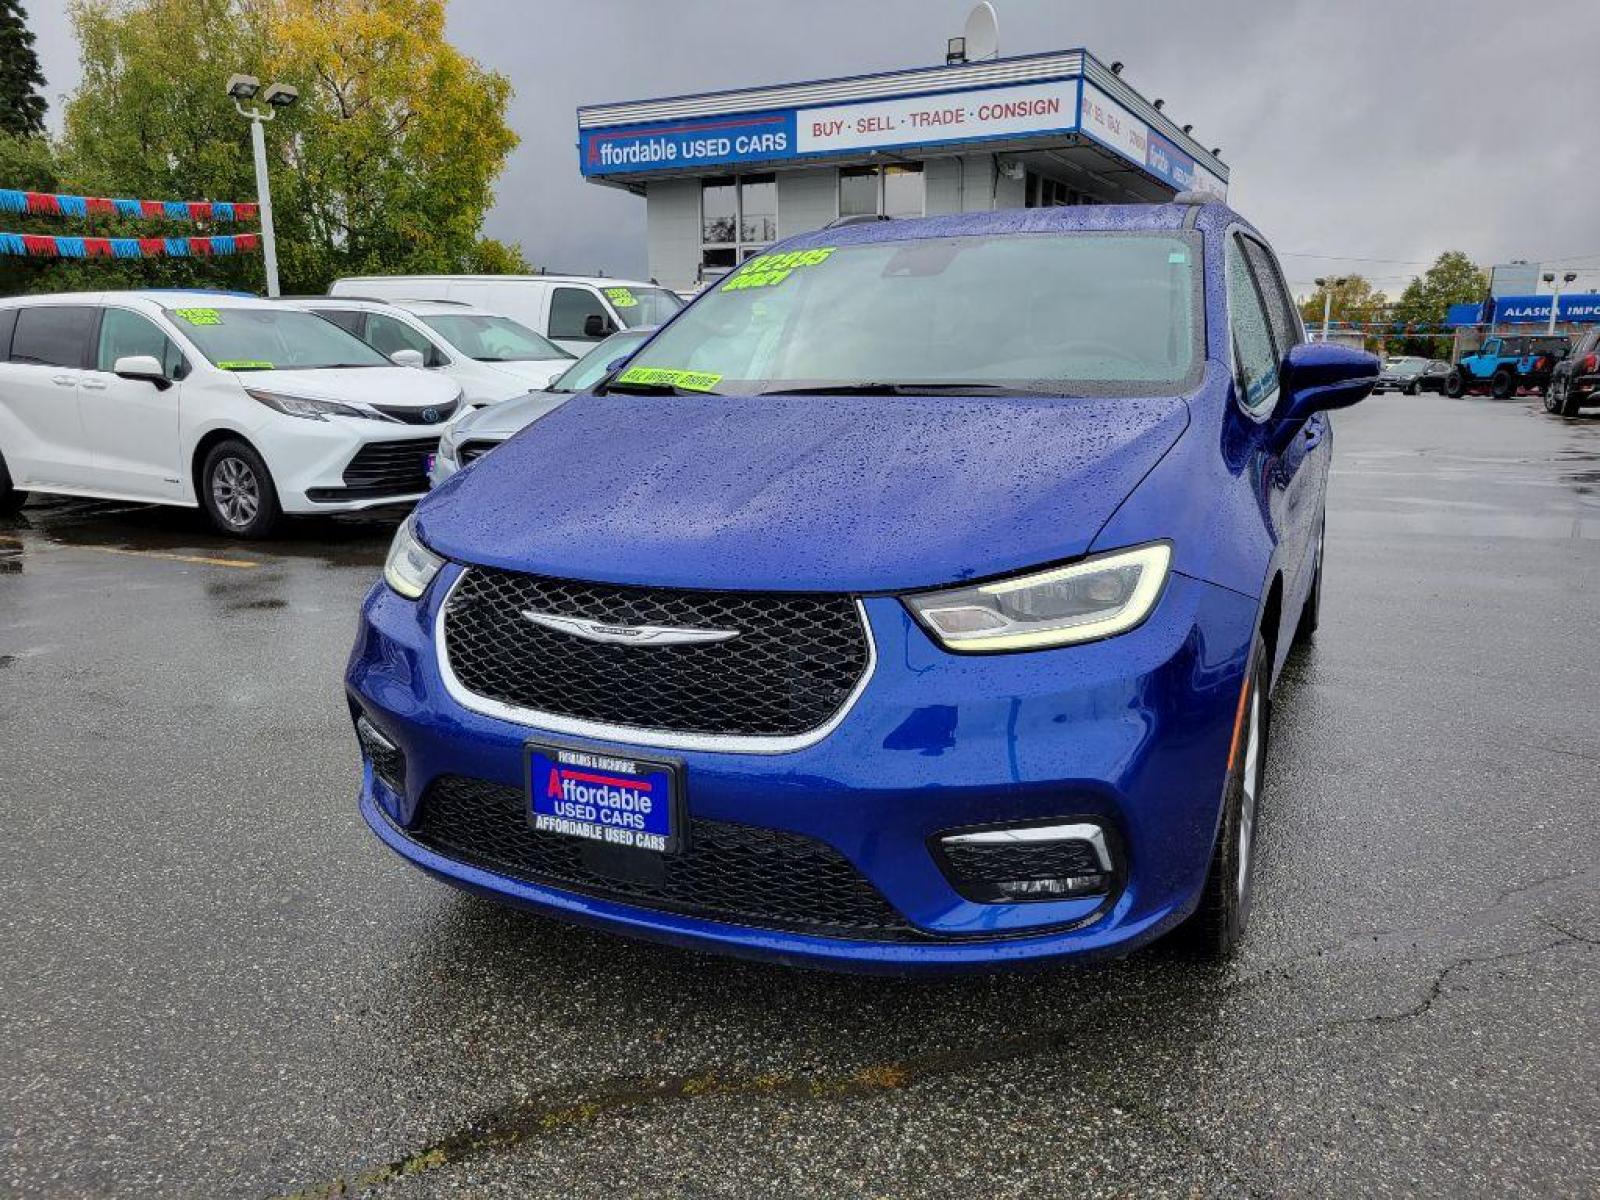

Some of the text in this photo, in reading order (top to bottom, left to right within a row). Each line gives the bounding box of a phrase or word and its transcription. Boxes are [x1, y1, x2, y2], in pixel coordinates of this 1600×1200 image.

[812, 97, 1060, 138] BUY SELL TRADE CONSIGN
[587, 132, 787, 167] Affordable USED CARS
[548, 769, 652, 813] Affordable
[554, 800, 646, 829] USED CARS
[536, 816, 666, 851] AFFORDABLE USED CARS
